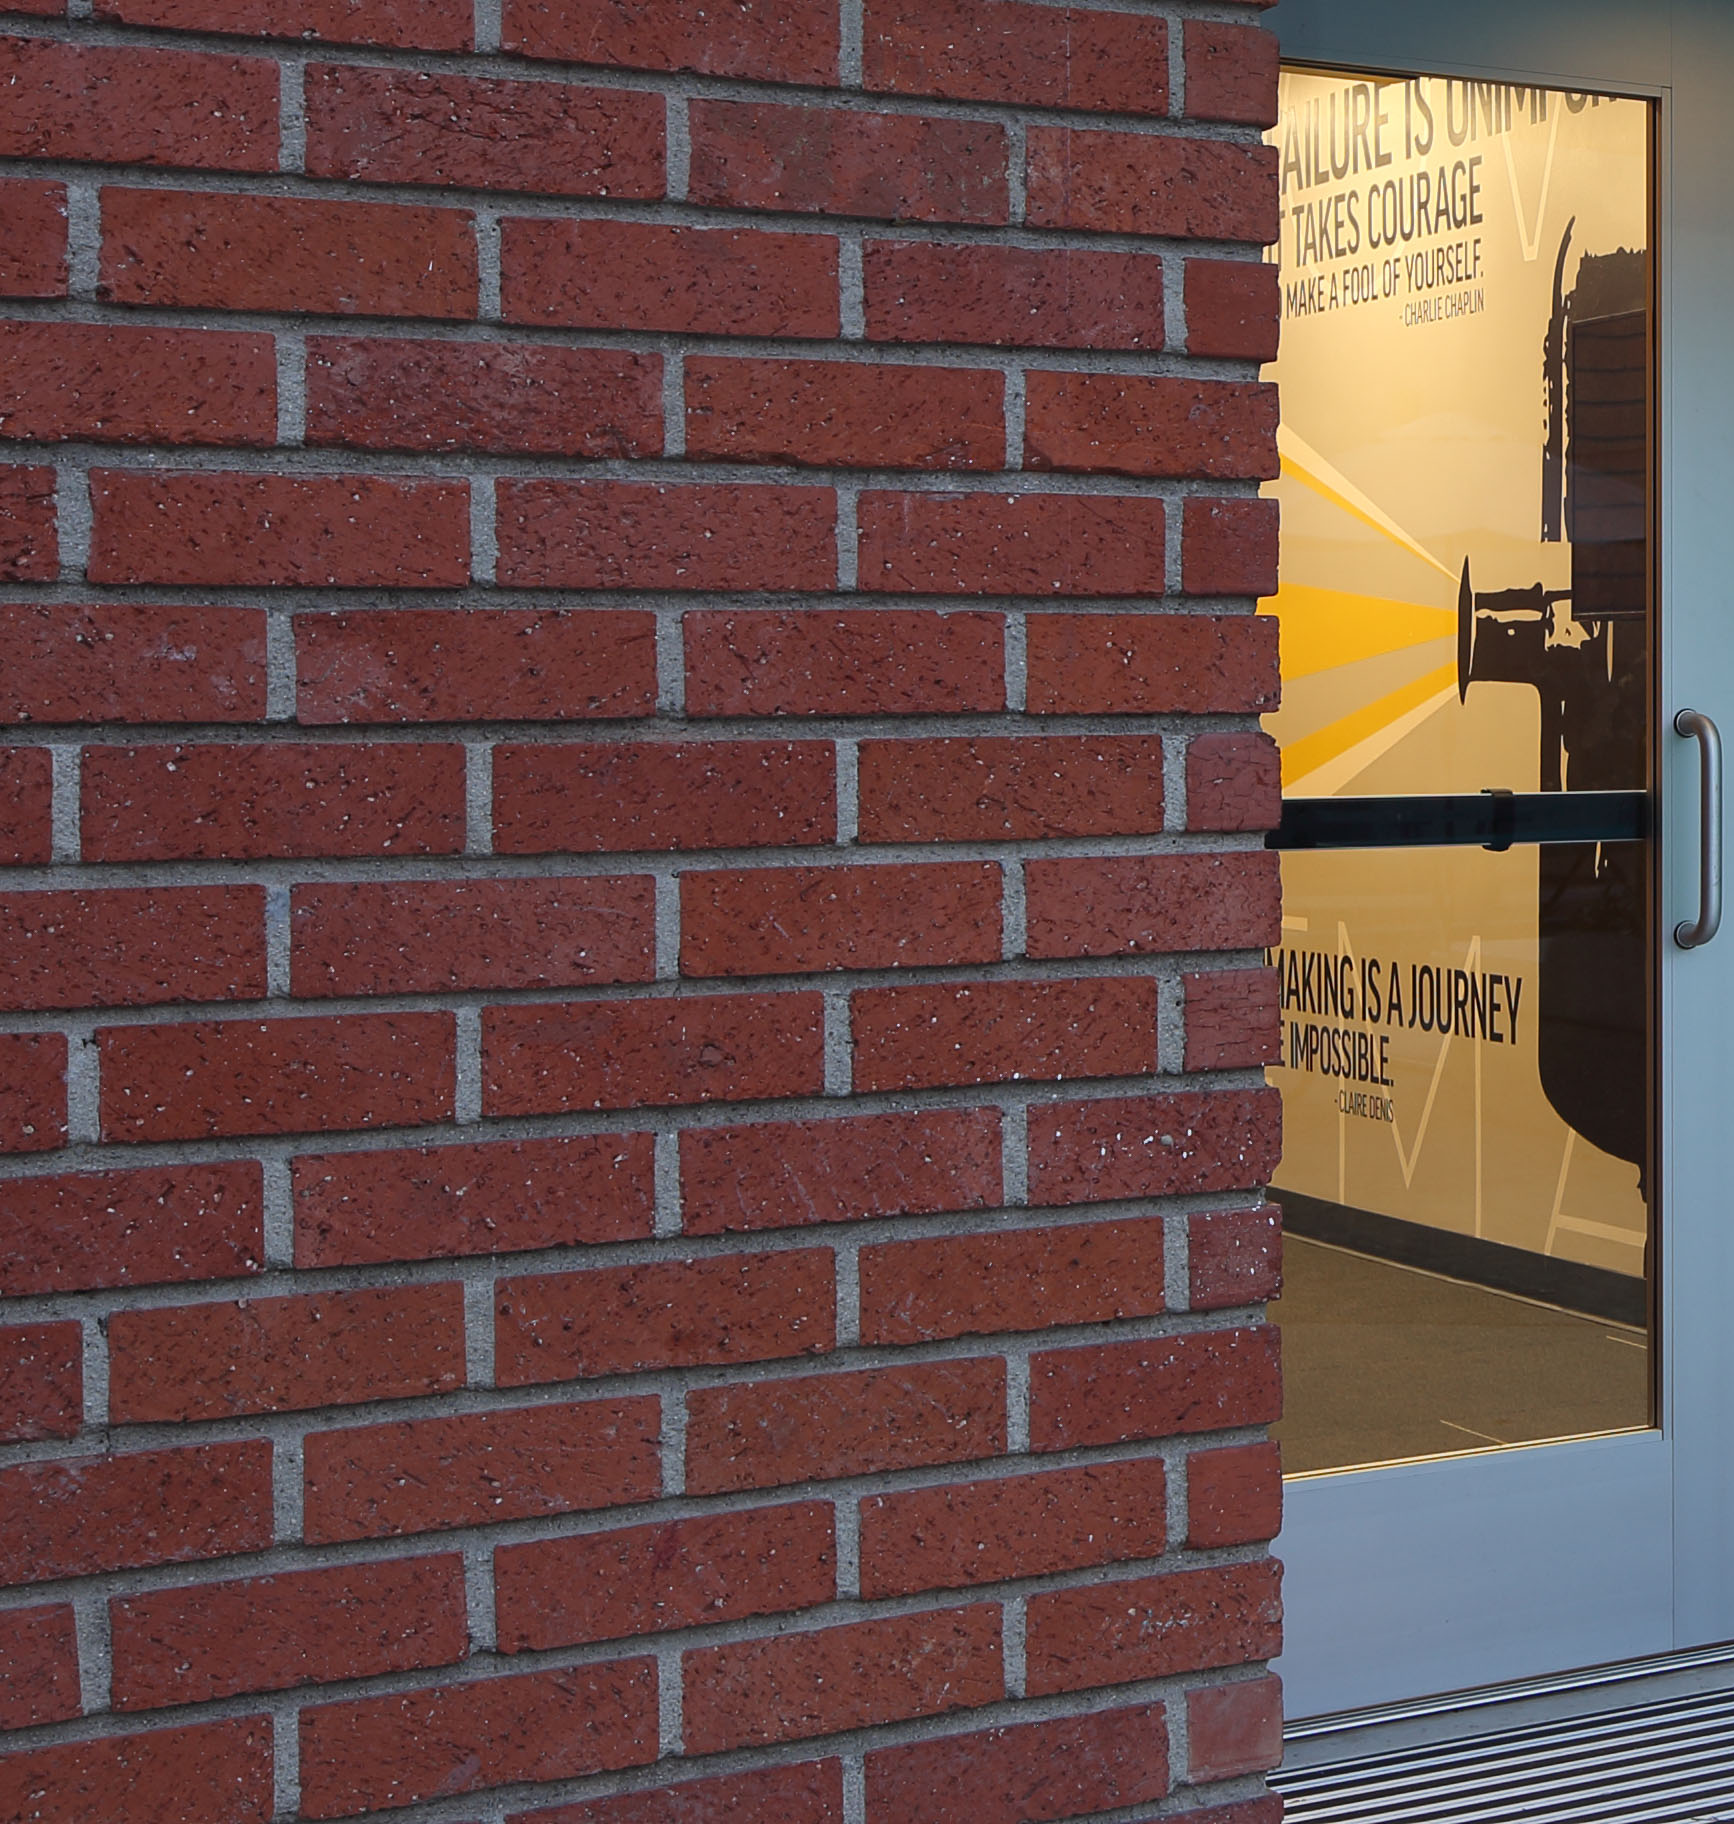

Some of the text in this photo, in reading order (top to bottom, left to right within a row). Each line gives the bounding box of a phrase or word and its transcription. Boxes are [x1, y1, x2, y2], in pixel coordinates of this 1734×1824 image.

[1267, 80, 1393, 195] AILURE
[1405, 77, 1434, 161] IS
[1292, 189, 1361, 269] TAKES
[1367, 156, 1484, 251] COURAGE
[1285, 275, 1326, 320] MAKE
[1329, 272, 1340, 311] A
[1342, 263, 1379, 308] FOOL
[1382, 257, 1401, 299] OF
[1404, 237, 1485, 294] YOURSELF.
[1404, 296, 1444, 328] CHARLIE
[1444, 287, 1485, 320] CHAPLIN
[1360, 957, 1382, 1024] IS
[1386, 961, 1404, 1028] A
[1407, 963, 1523, 1046] JOURNEY
[1289, 1020, 1395, 1088] IMPOSSIBLE.
[1338, 1089, 1368, 1118] CLAIRE
[1369, 1094, 1394, 1124] DENIS
